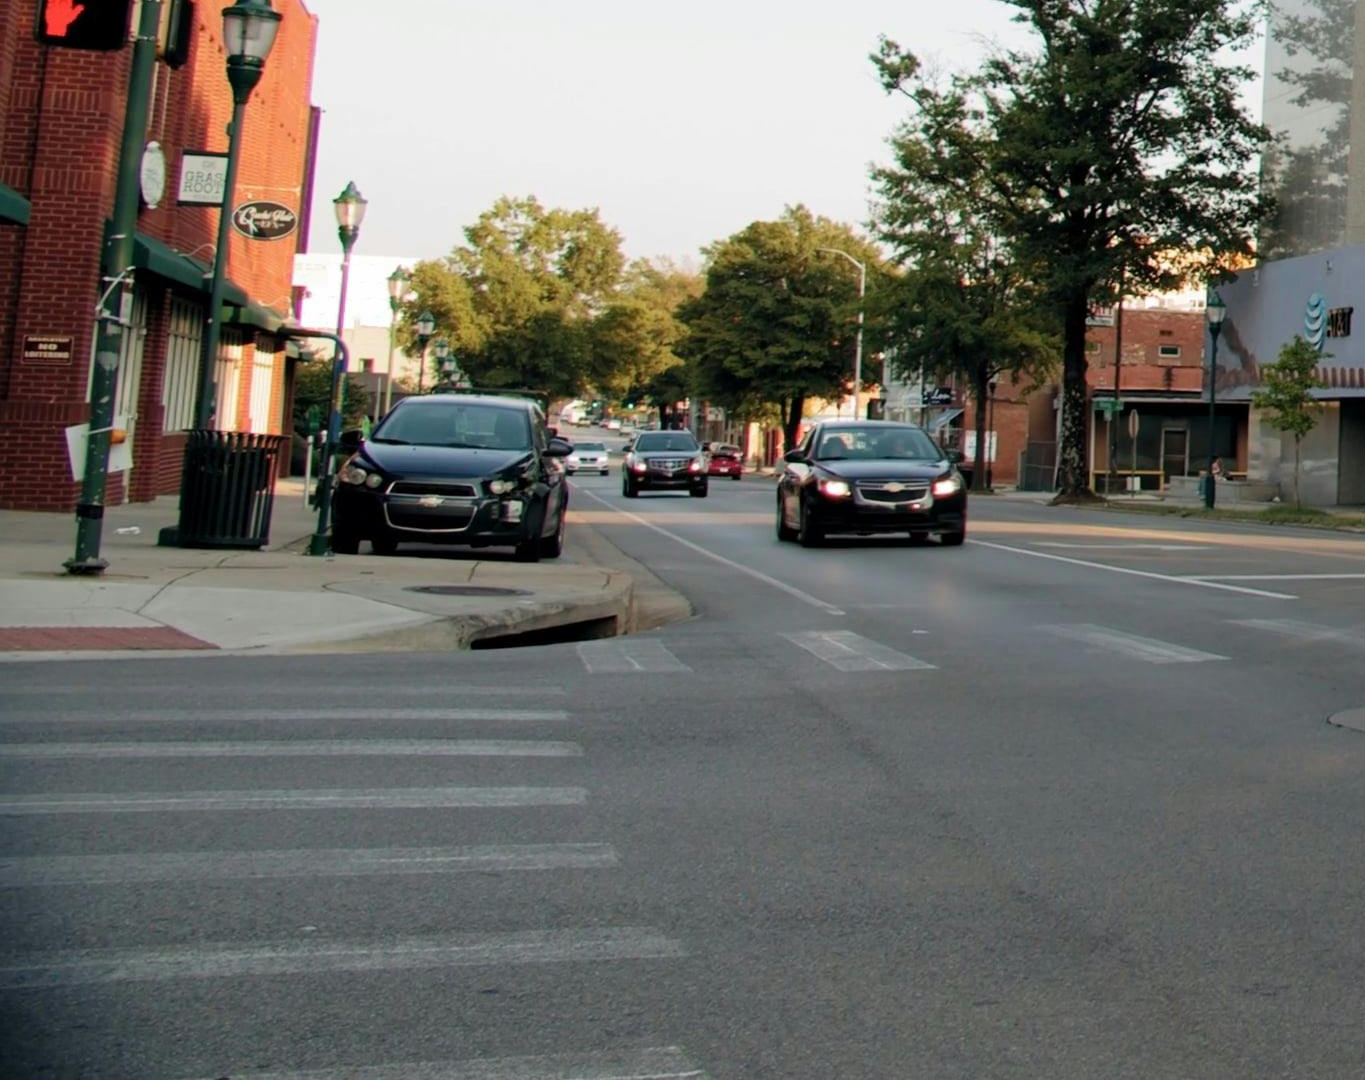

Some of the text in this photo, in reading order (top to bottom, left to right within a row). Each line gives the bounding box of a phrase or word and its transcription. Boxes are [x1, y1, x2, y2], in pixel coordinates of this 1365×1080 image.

[184, 171, 224, 183] GRAS
[183, 182, 222, 194] ROOT
[1326, 306, 1354, 338] AT&T
